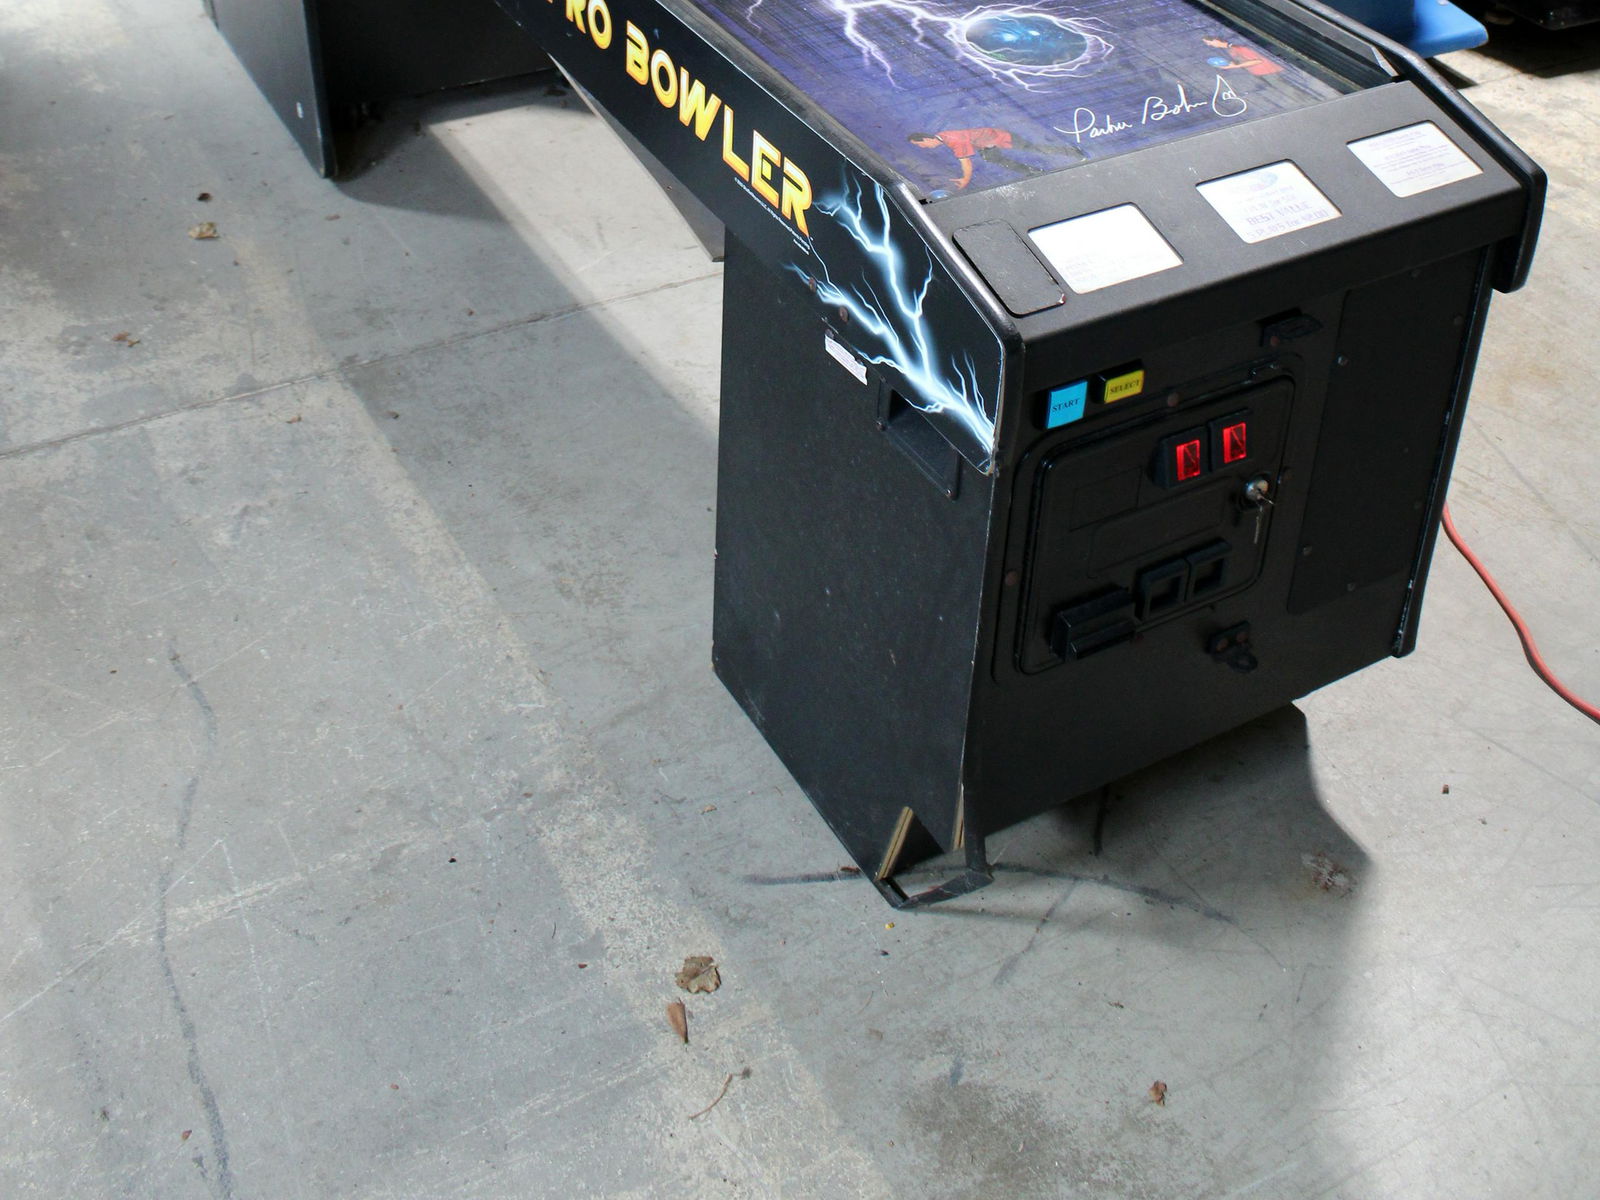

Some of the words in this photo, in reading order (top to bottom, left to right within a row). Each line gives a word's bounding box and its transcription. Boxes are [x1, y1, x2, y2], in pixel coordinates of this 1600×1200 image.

[626, 19, 813, 238] BOWLER
[1109, 380, 1140, 393] SELECT
[1052, 398, 1081, 412] START
